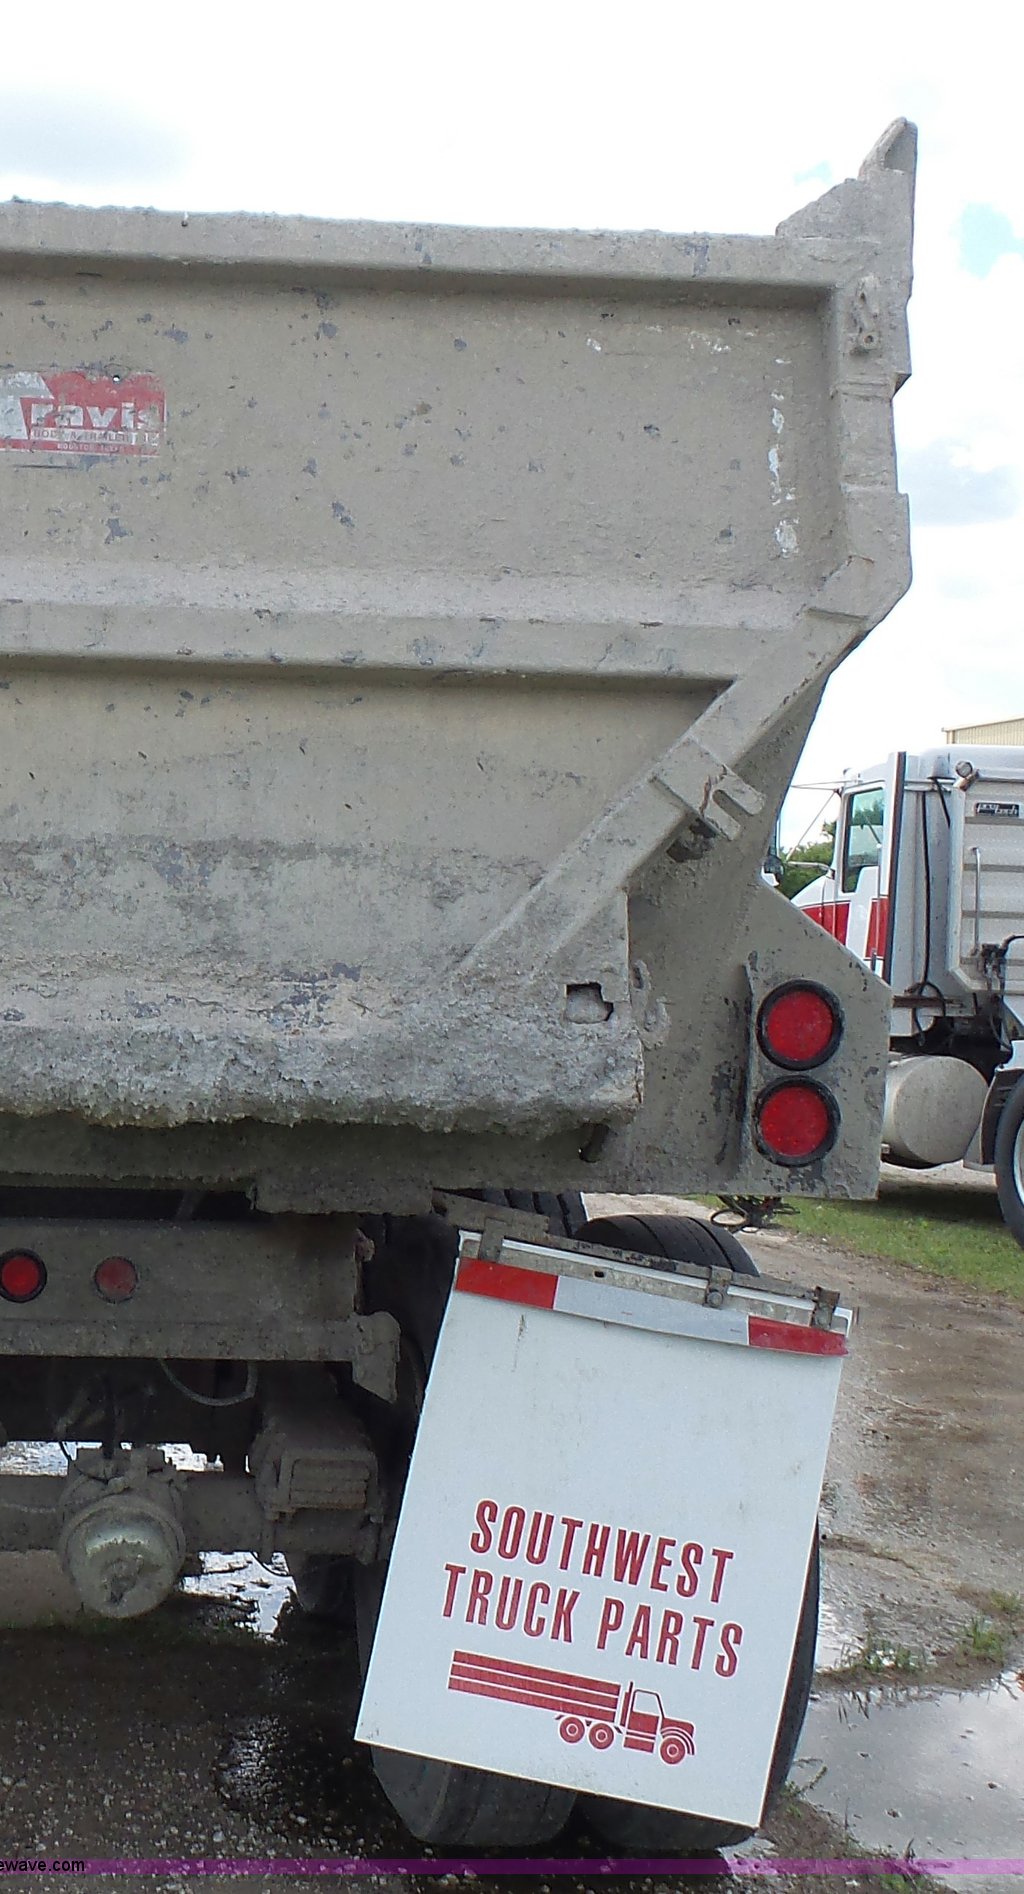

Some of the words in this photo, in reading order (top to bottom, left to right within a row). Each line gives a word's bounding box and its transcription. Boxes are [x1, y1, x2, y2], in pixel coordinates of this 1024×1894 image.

[469, 1499, 734, 1603] SOUTHWEST
[442, 1563, 580, 1643] TRUCK
[596, 1597, 744, 1679] PARTS
